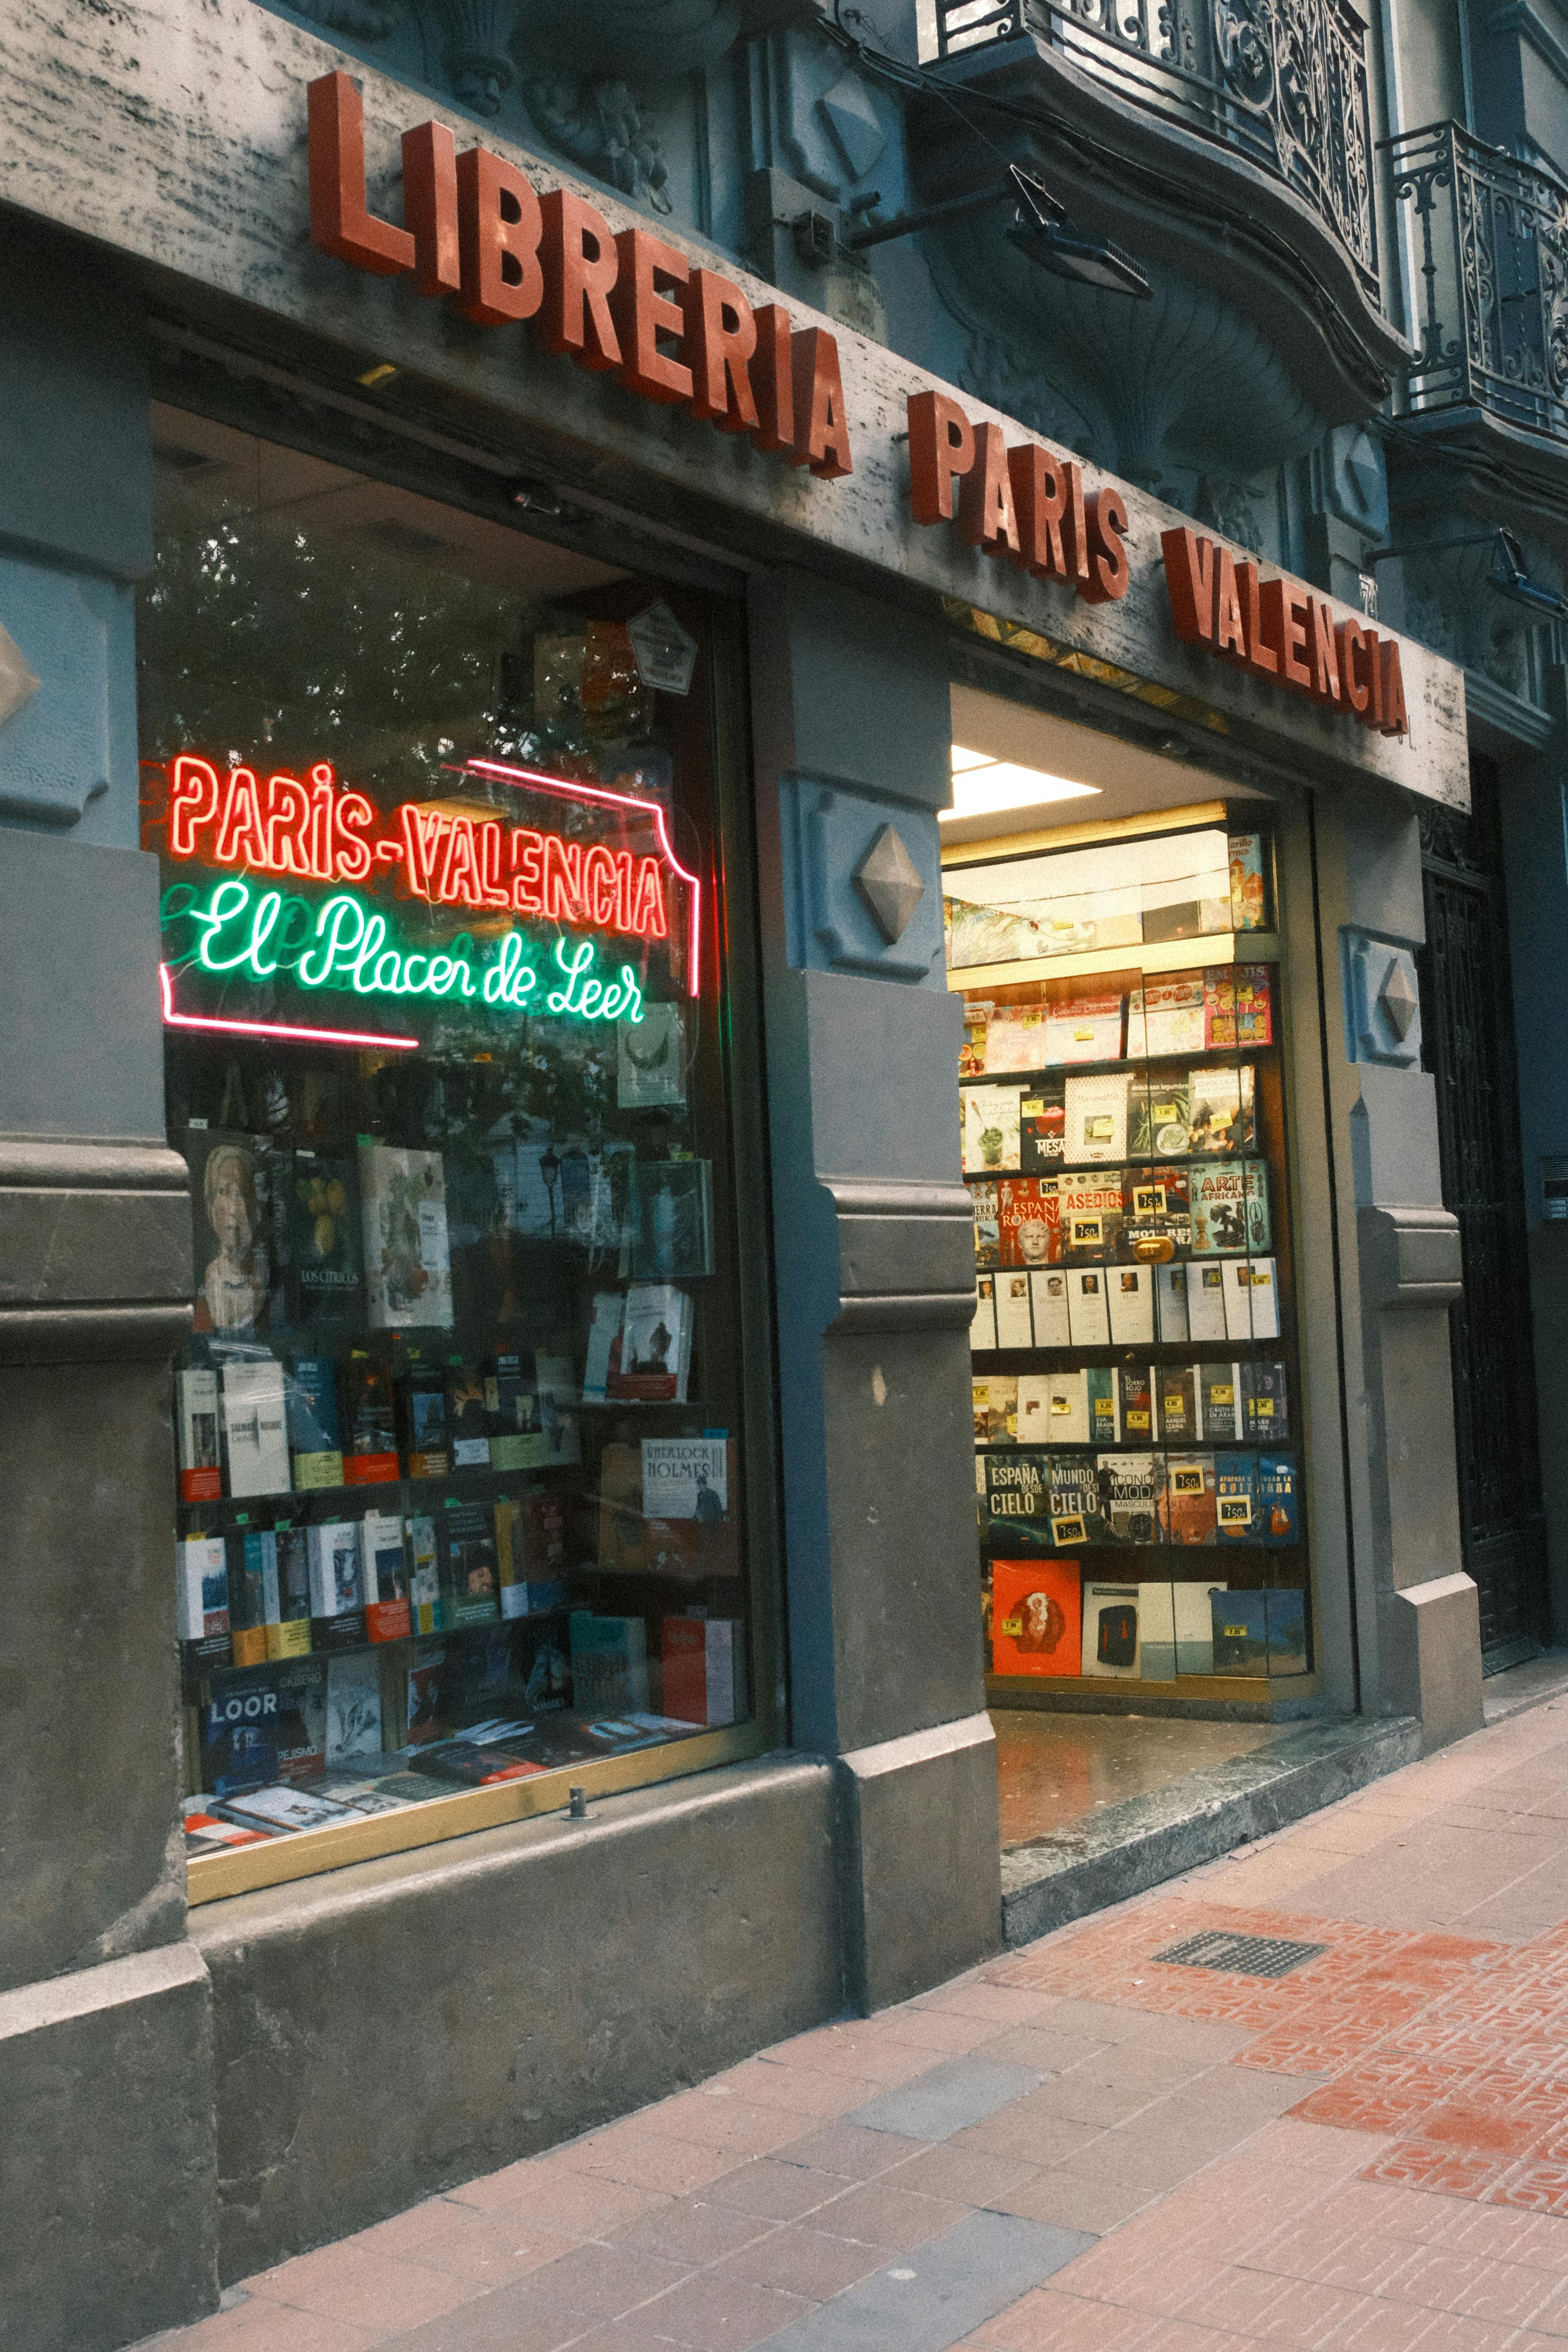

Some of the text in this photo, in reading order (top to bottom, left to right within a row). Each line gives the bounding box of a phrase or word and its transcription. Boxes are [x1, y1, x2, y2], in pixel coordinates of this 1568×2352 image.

[308, 70, 1408, 737] LIBRERIA PARIS VALENCIA
[191, 880, 643, 1022] El Placer de Leer
[1201, 1174, 1254, 1193] ARTE
[647, 1446, 710, 1459] SHERLOCK
[648, 1462, 710, 1478] HOLMES
[991, 1463, 1040, 1485] ESPAÑA
[1052, 1468, 1094, 1485] MUNDO
[1022, 1483, 1043, 1494] DESDE
[991, 1492, 1035, 1515] CIELO
[1050, 1492, 1096, 1515] CIELO
[211, 1693, 277, 1724] LOOR
